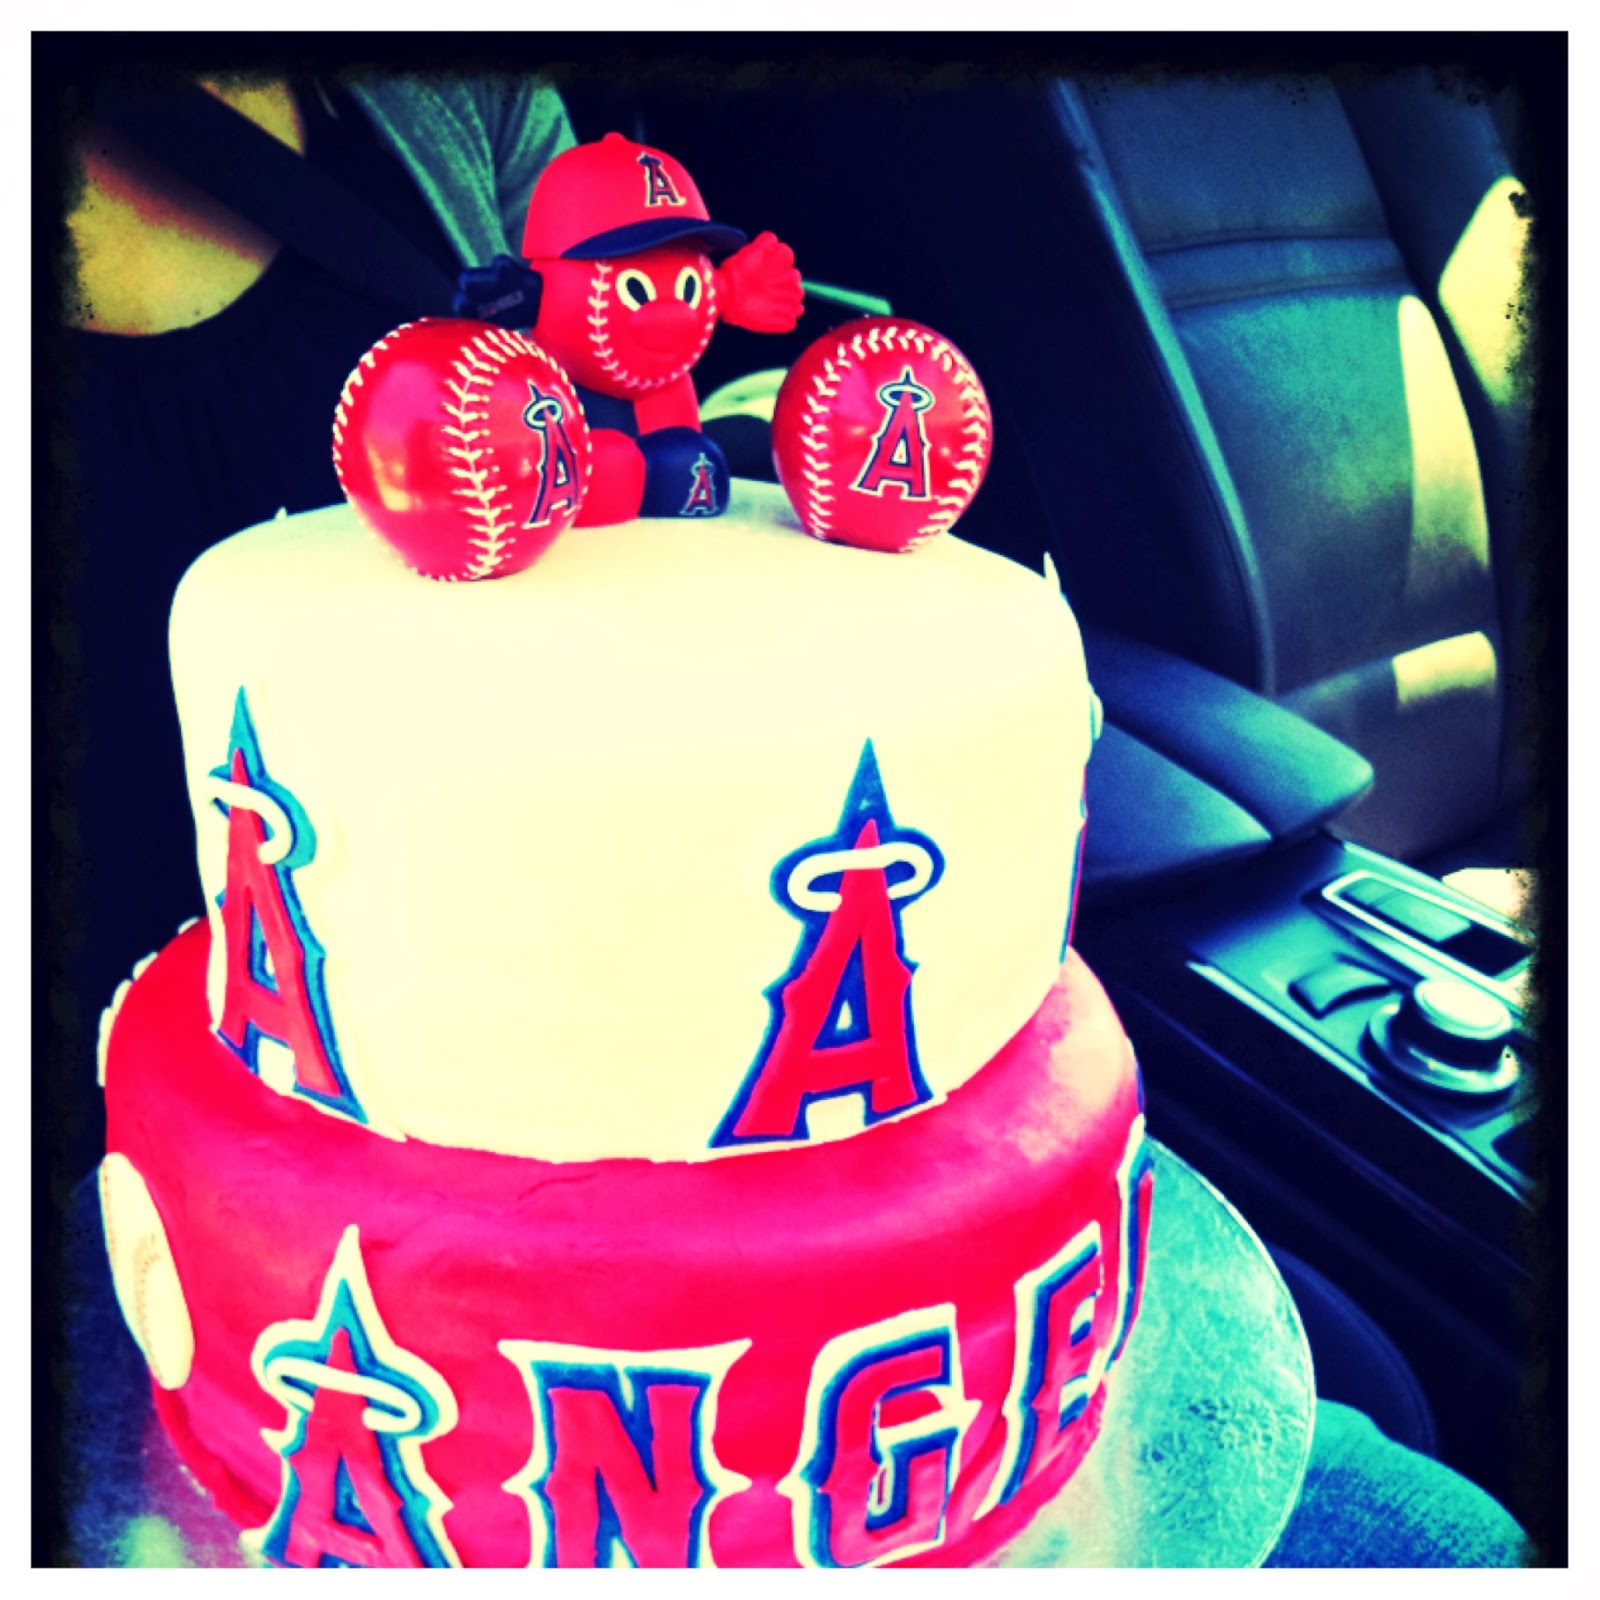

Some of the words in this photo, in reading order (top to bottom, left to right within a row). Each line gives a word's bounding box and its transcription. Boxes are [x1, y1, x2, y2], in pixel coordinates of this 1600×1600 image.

[637, 152, 687, 207] A
[521, 380, 580, 529] A
[679, 452, 720, 516] A
[848, 366, 933, 500] A
[207, 686, 370, 1124] A
[706, 737, 947, 1149] A
